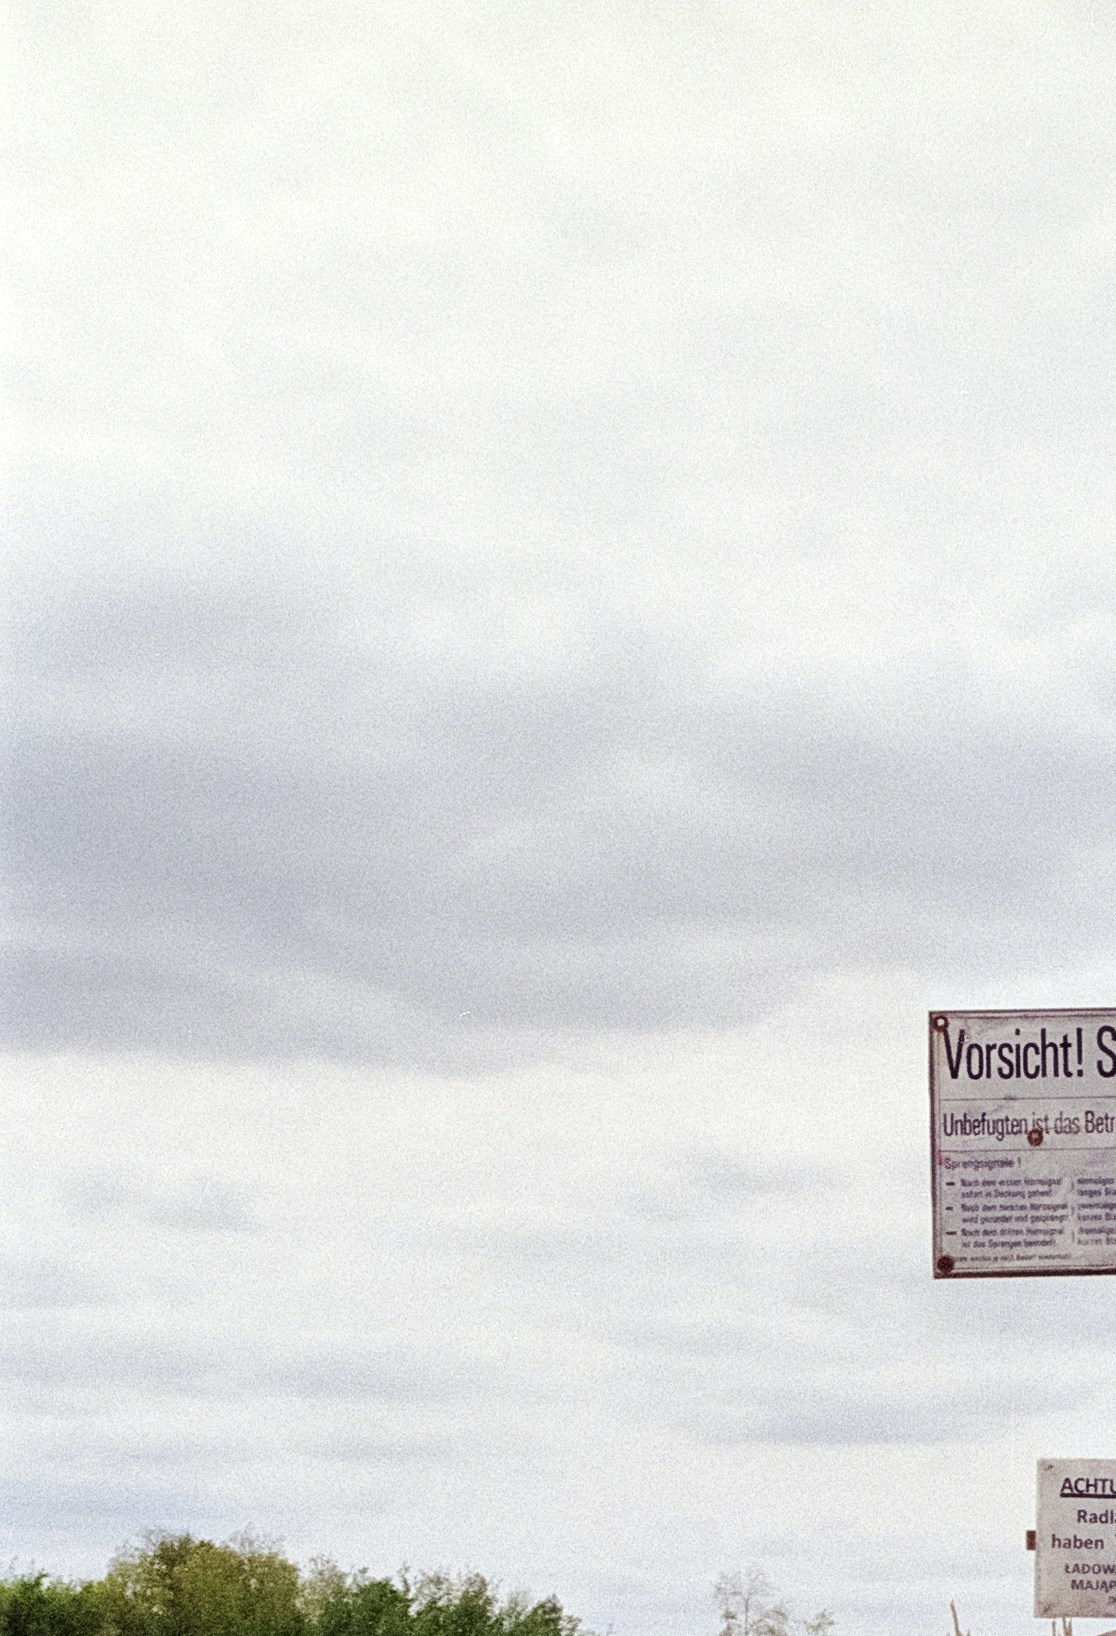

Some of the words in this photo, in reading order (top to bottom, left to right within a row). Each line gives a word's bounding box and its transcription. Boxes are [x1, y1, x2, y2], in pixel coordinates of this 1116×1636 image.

[942, 1026, 1083, 1080] Vorsicht!
[943, 1111, 1028, 1141] Unbefugten
[1031, 1111, 1050, 1135] ist
[1054, 1110, 1080, 1135] das
[1051, 1533, 1105, 1550] haben
